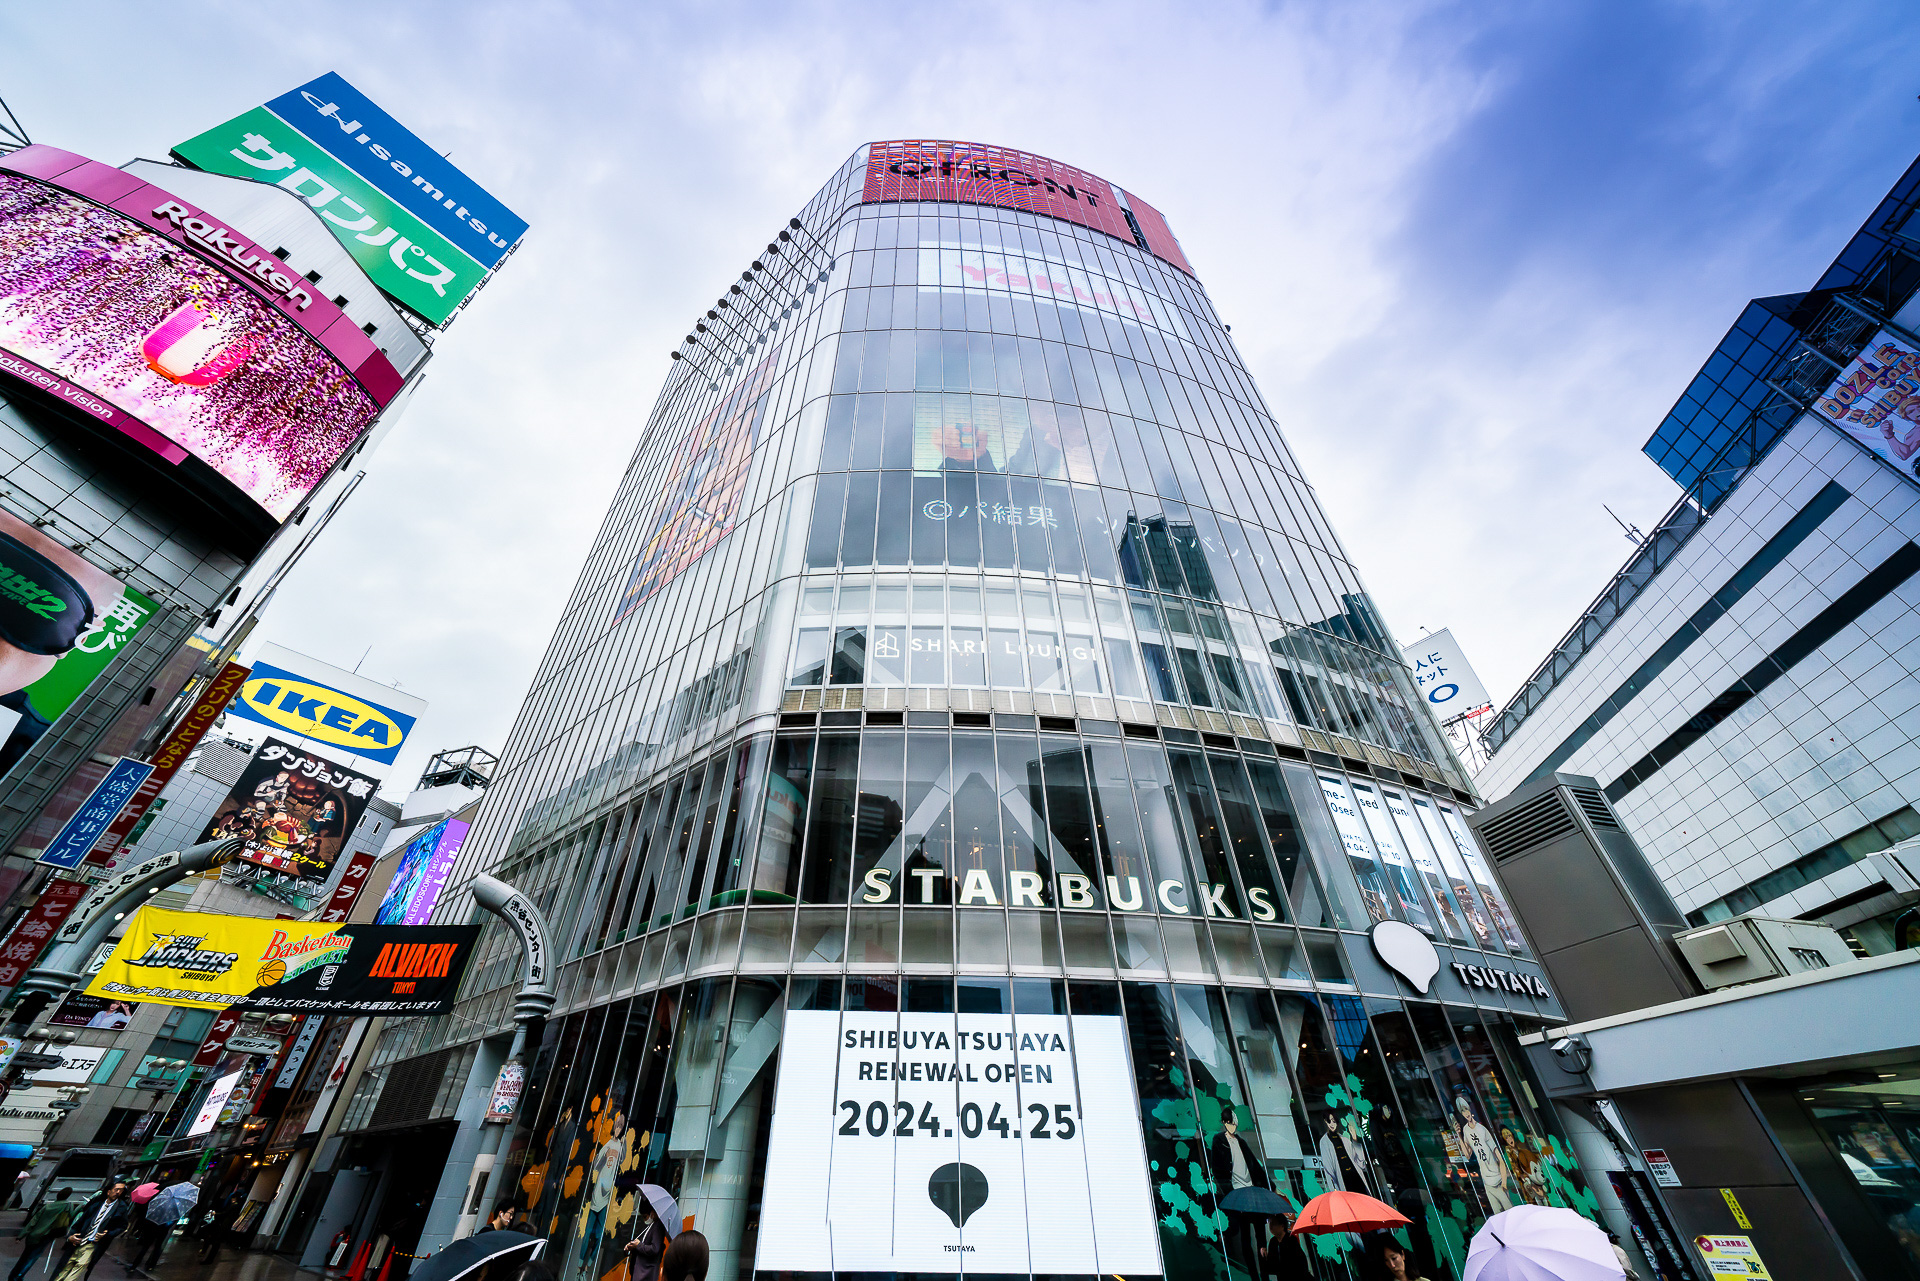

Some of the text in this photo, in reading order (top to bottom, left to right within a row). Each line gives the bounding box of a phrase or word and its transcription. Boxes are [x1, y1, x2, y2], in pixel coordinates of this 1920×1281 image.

[300, 90, 508, 248] Hisamitsu
[230, 132, 457, 298] サロンパス
[152, 200, 313, 312] Rakuten
[956, 263, 1153, 321] Yakult
[0, 352, 114, 419] akuten Vision
[1821, 343, 1900, 418] DOZLE
[1860, 368, 1920, 429] SHIBUY
[74, 592, 150, 653] 再び
[1415, 665, 1448, 686] ネット
[1416, 652, 1443, 672] 人に
[158, 669, 244, 769] クスリのことなら
[251, 681, 392, 746] IKEA
[259, 744, 374, 800] ダンジョン飯
[97, 777, 164, 854] 三千里
[50, 885, 81, 897] 元氣
[62, 855, 174, 939] 渋谷センター街
[862, 867, 1278, 921] STARBUCKS
[0, 900, 70, 983] 七輪焼肉
[128, 935, 240, 974] ROCKERS
[172, 934, 203, 949] SUN
[258, 929, 354, 962] Basketball
[368, 942, 459, 978] ALVARK
[509, 899, 542, 980] 渋谷センター街
[180, 971, 217, 982] SHIBUYA
[391, 981, 417, 994] TOKYO
[1452, 961, 1551, 999] TSUTAYA
[203, 1018, 236, 1054] オケ
[844, 1029, 1066, 1053] SHIBUYA TSUTAYA
[858, 1061, 1053, 1084] RENEWAL OPEN
[838, 1099, 1076, 1140] 2024.04.25
[943, 1244, 976, 1253] TSUTAYA
